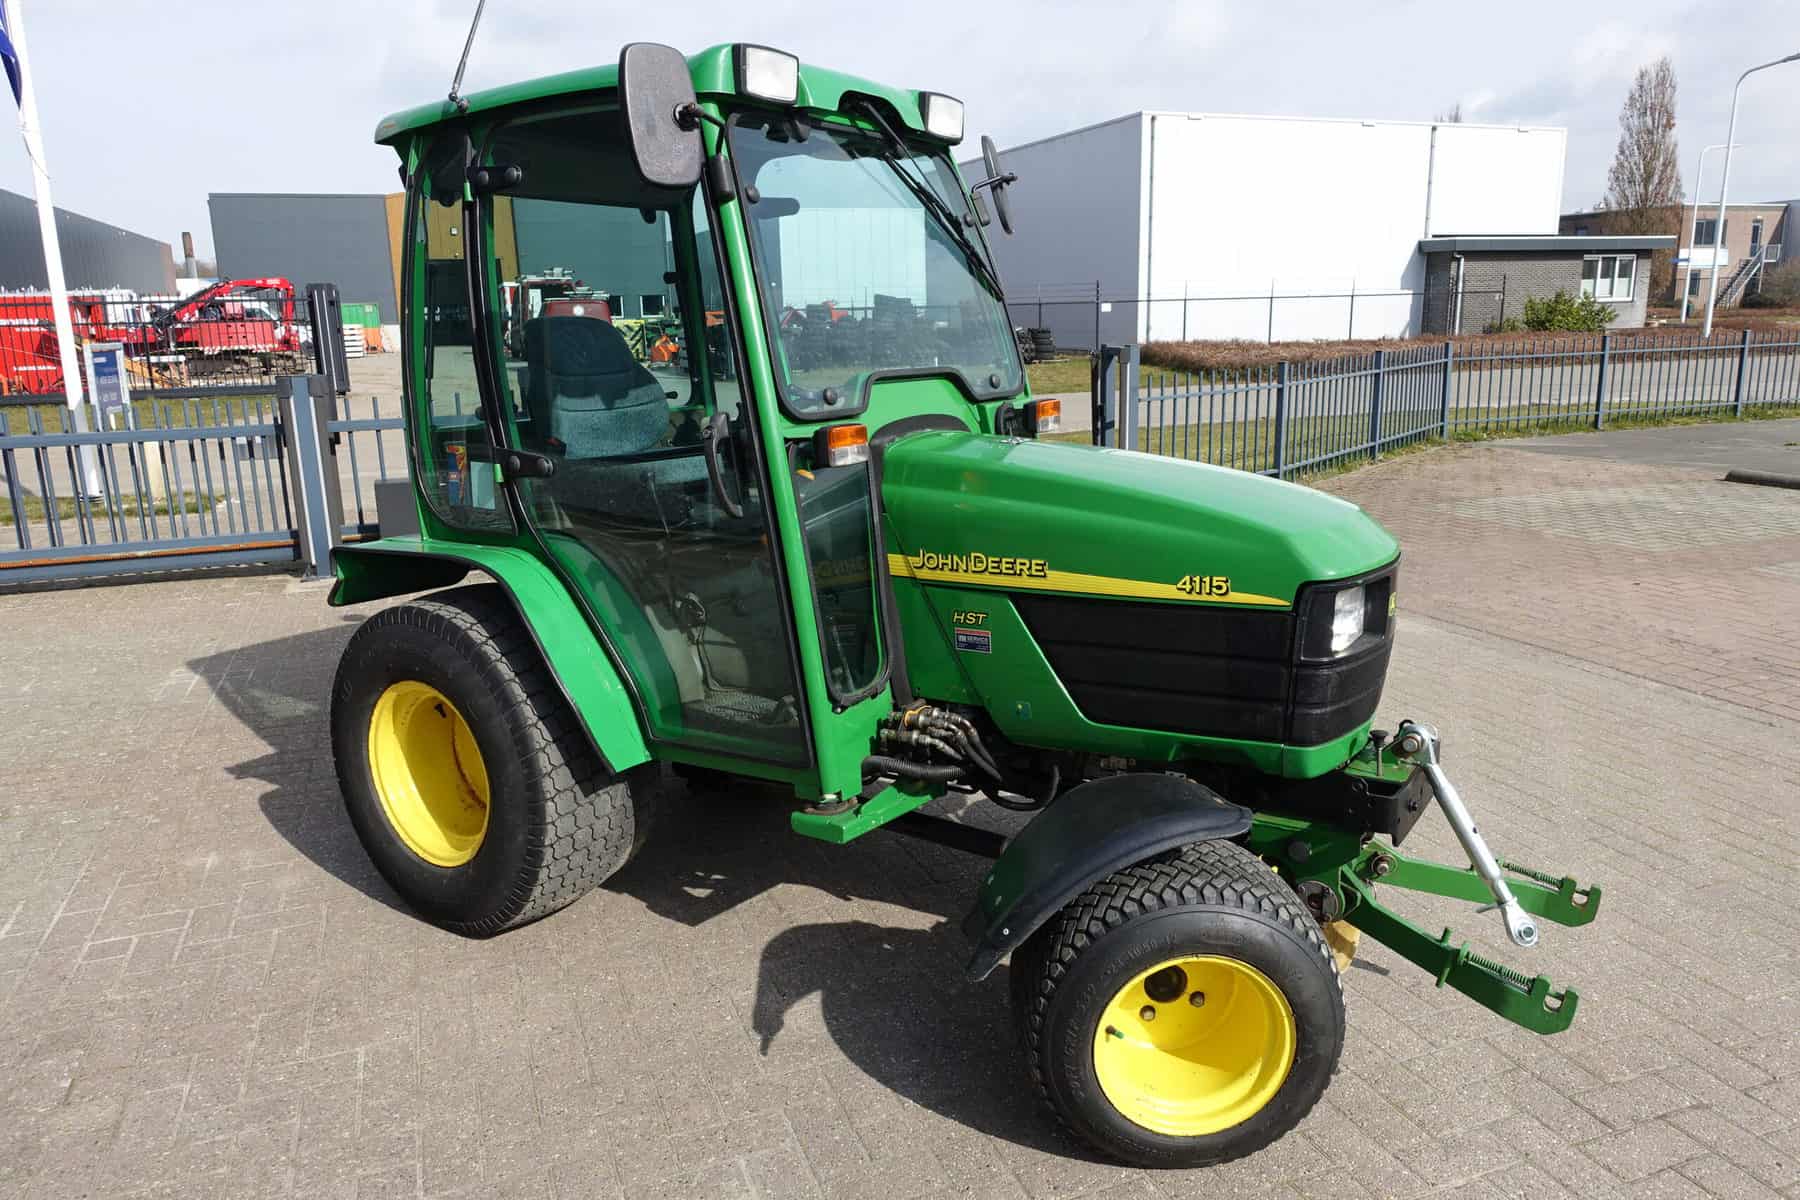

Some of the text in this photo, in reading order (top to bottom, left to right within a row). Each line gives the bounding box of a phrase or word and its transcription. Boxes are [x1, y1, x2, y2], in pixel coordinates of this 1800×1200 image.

[912, 548, 1047, 577] JOHN DEERE
[1176, 575, 1230, 596] 4115
[953, 611, 987, 625] HST
